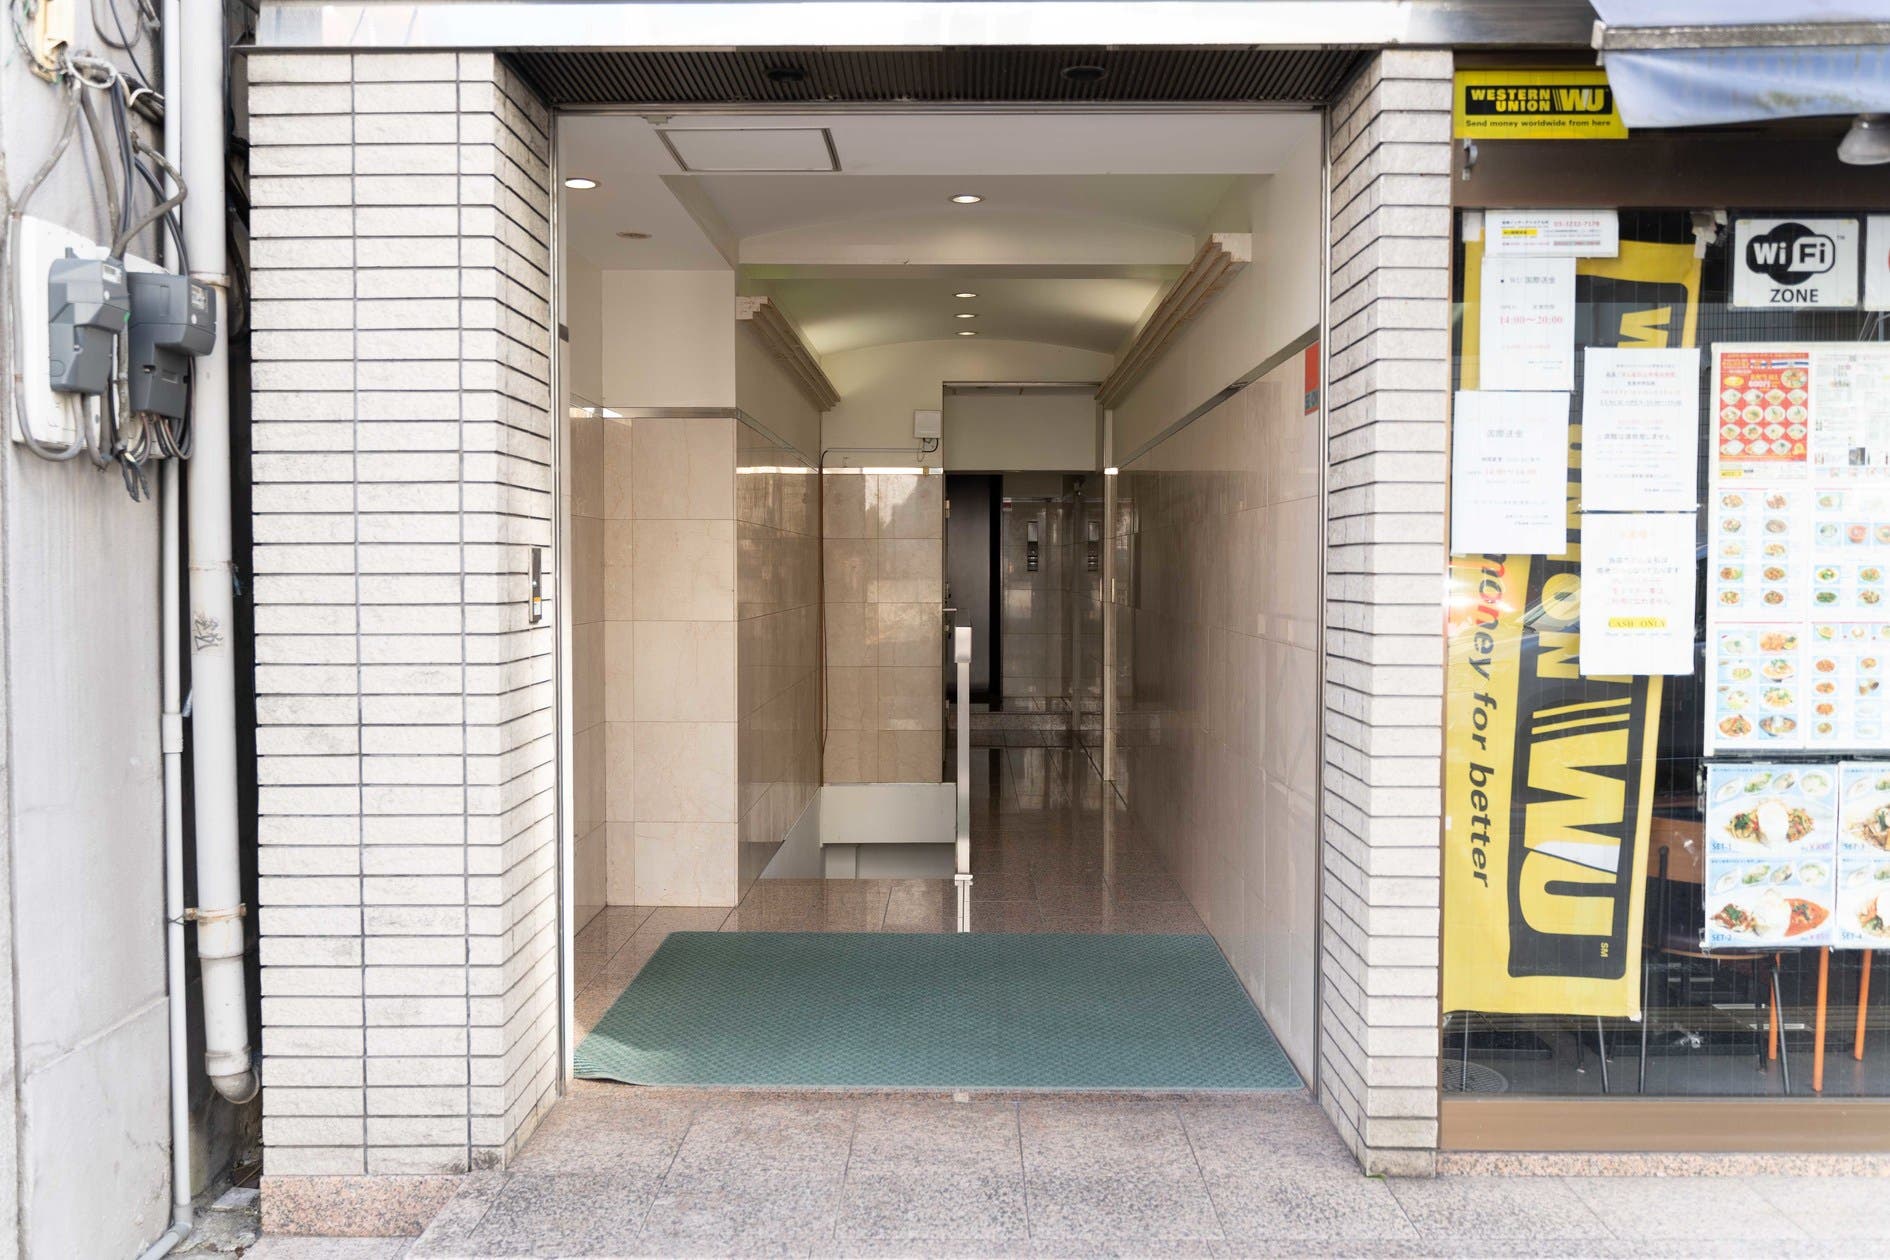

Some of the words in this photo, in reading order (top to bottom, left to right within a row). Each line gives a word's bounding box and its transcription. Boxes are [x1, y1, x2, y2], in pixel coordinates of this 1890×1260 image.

[1471, 89, 1550, 101] WESTERN
[1560, 88, 1604, 112] WU
[1496, 101, 1550, 112] UNION
[1770, 289, 1819, 303] ZONE
[1472, 692, 1498, 751] for
[1469, 761, 1495, 888] better
[1519, 728, 1630, 937] WU
